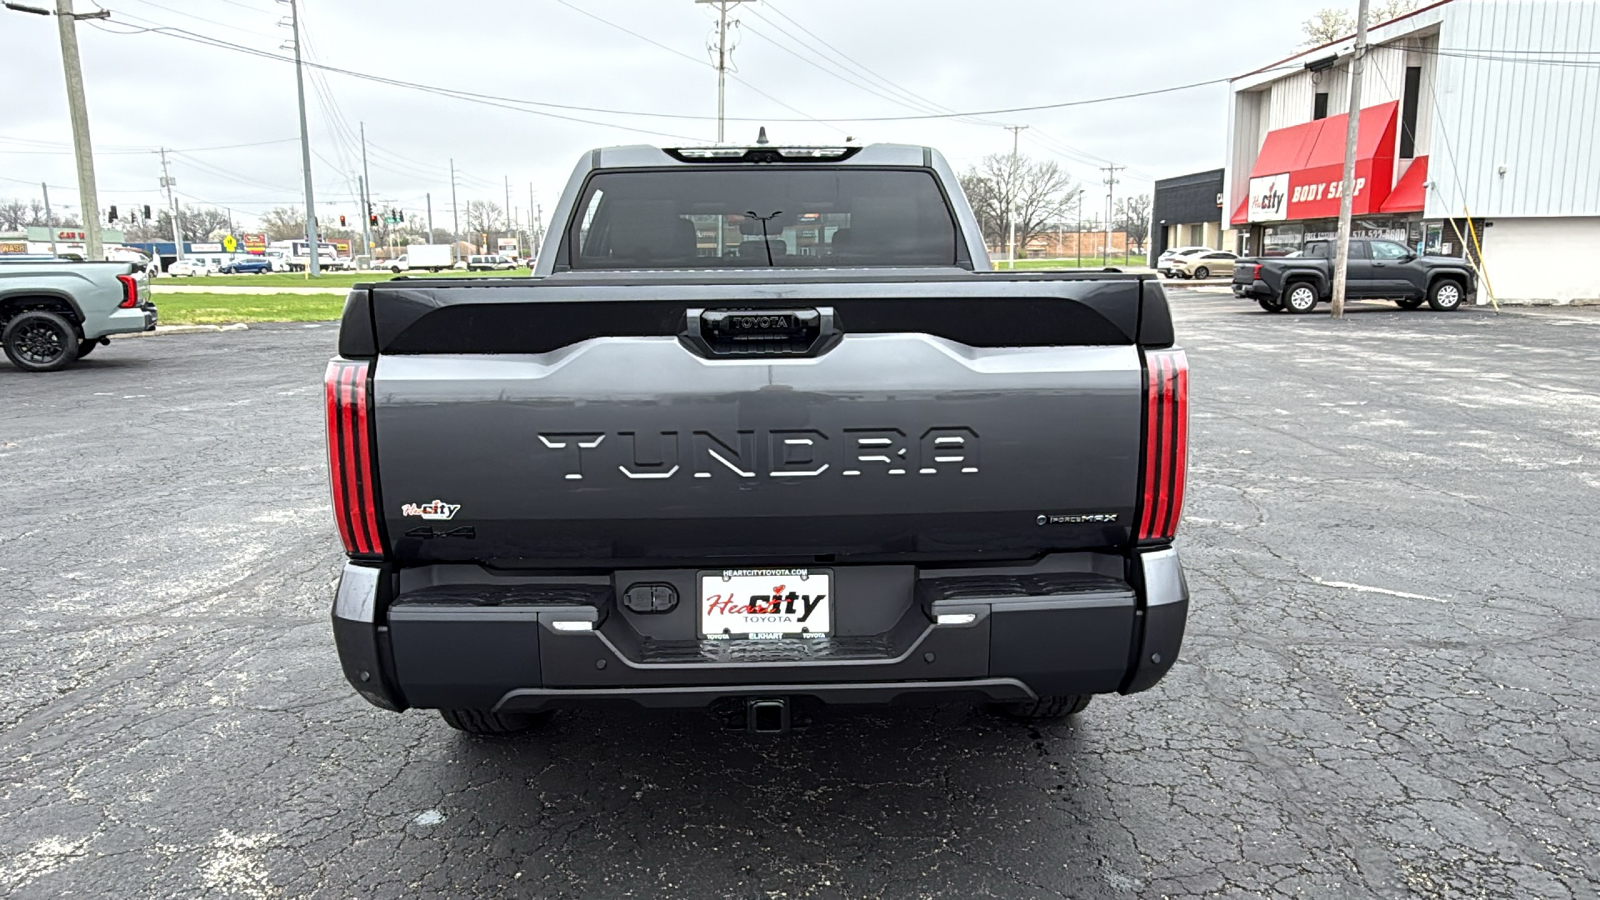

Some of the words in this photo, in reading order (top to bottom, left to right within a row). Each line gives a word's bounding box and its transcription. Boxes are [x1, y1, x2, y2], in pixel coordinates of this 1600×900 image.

[1261, 189, 1285, 214] city
[1292, 183, 1326, 202] BODY
[1327, 178, 1366, 199] SHP
[58, 231, 76, 240] CAR
[2, 244, 25, 252] WASH
[733, 316, 788, 329] TOYOTA
[537, 426, 980, 480] TUNDRA
[706, 593, 791, 616] Heart
[748, 588, 826, 622] city
[748, 632, 783, 640] ELKHART
